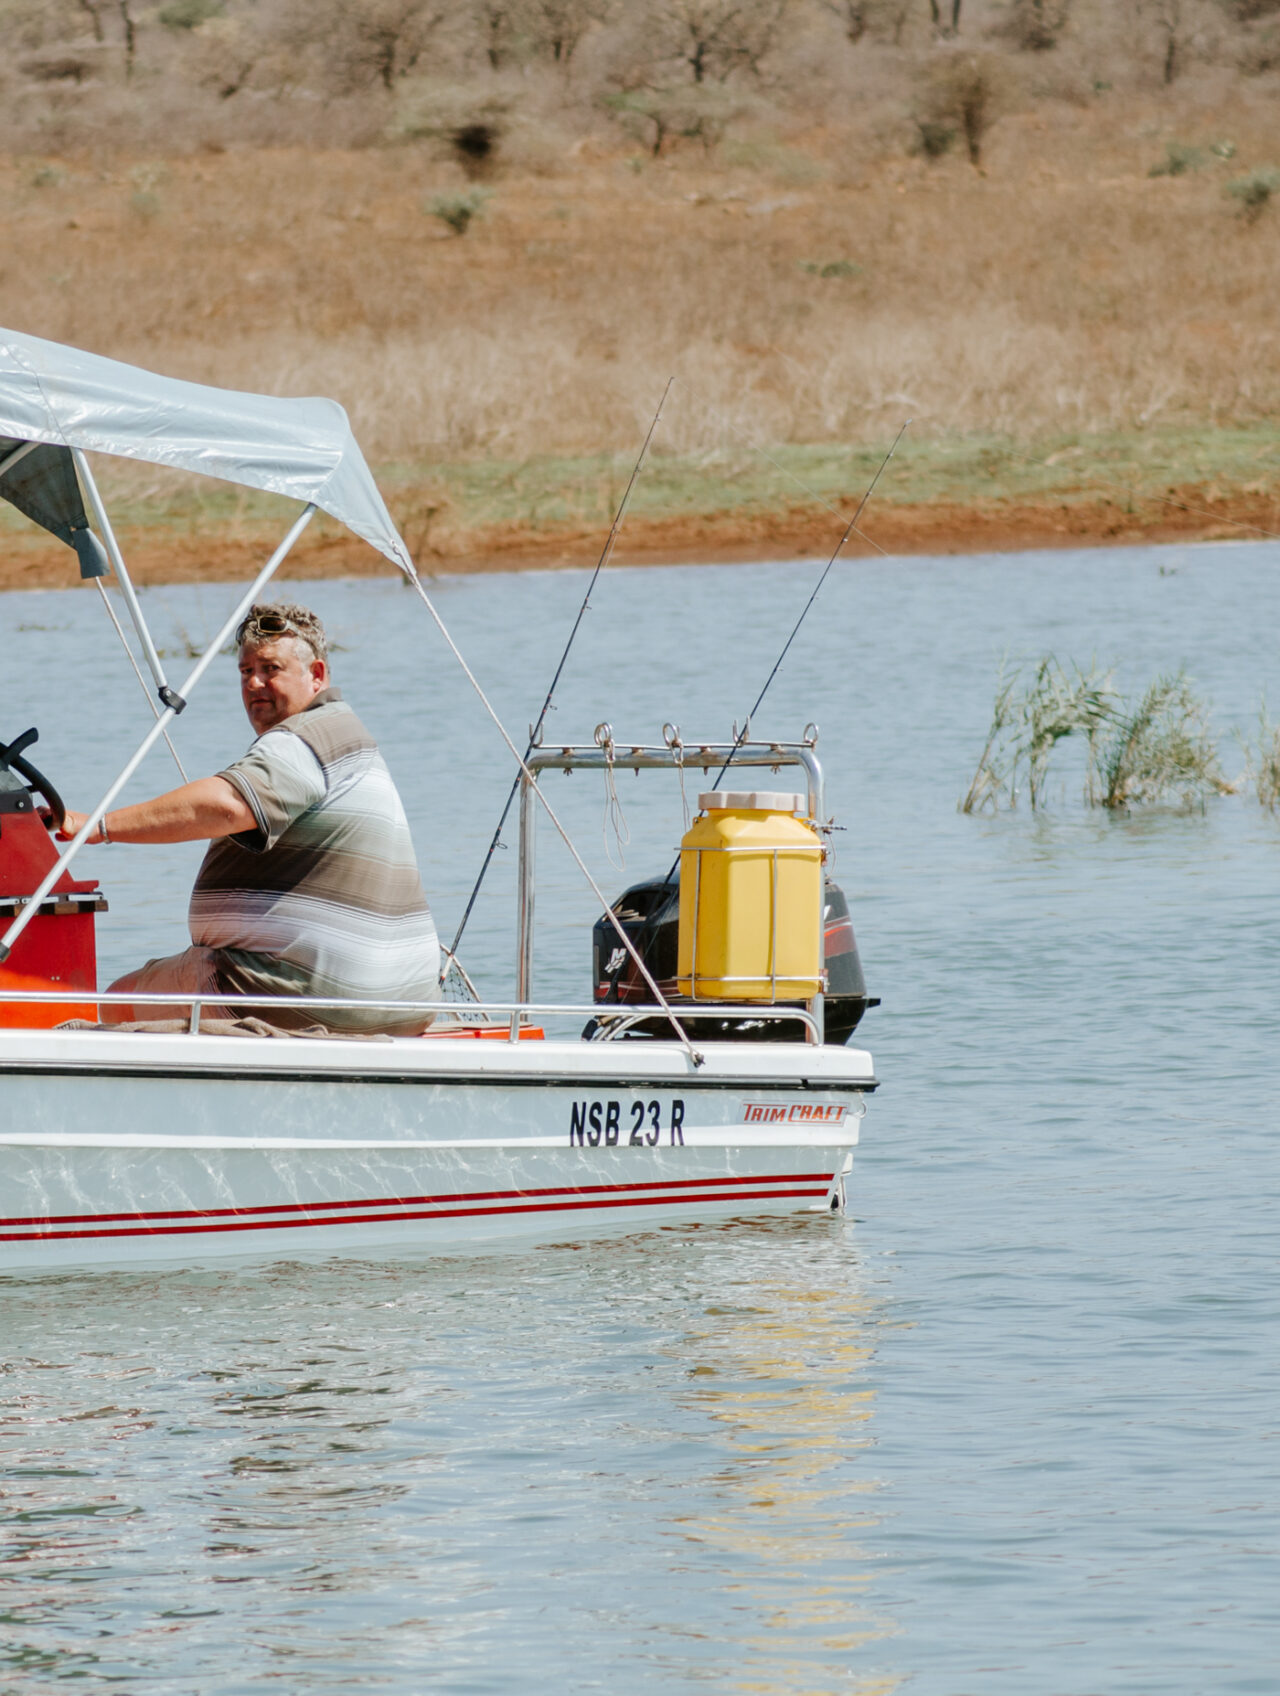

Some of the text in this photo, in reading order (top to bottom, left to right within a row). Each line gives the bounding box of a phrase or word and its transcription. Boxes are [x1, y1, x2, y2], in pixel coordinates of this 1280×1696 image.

[570, 1099, 685, 1147] NSB 23 R
